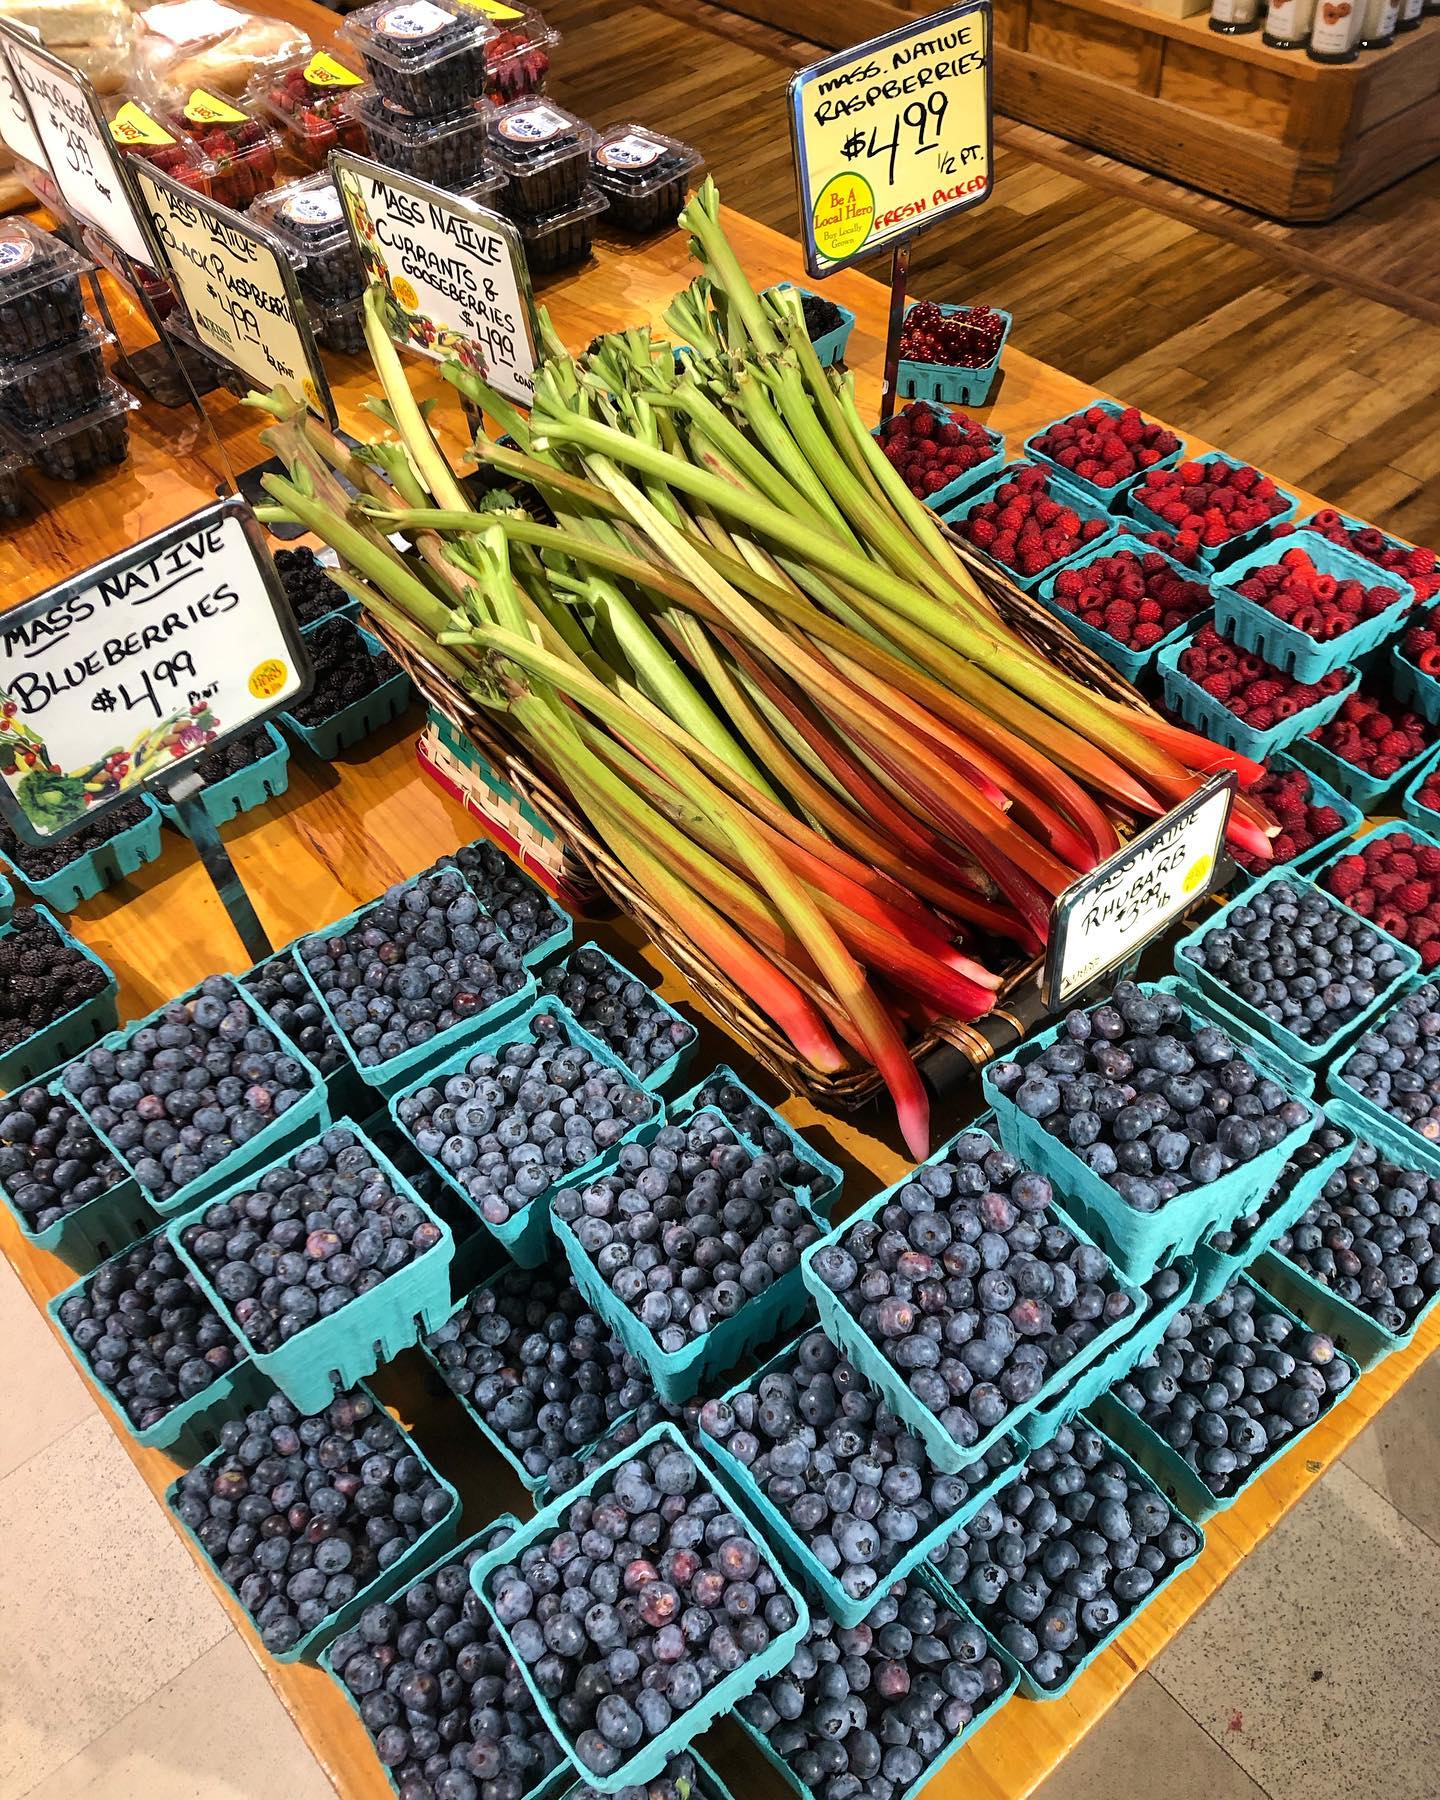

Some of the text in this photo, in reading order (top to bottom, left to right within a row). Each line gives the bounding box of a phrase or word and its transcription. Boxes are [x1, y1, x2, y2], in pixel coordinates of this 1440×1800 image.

[893, 27, 972, 69] NATIVE
[814, 51, 986, 126] RASPBERRIES
[115, 123, 141, 140] FOXY
[153, 183, 197, 224] MASS
[200, 206, 258, 261] NATIVE
[371, 180, 425, 224] MASS
[429, 202, 503, 262] NATIVE
[815, 203, 873, 230] Local Hero
[831, 188, 856, 208] Be A
[874, 175, 987, 230] FRESH PICKED
[153, 213, 215, 278] BLACK
[376, 218, 499, 302] CURRANTS &
[402, 256, 515, 333] GOOSEBERRIES
[1, 527, 225, 658] MASS NATIVE
[7, 583, 240, 714] BLUEBERRIES
[1081, 844, 1186, 935] RHUBARB
